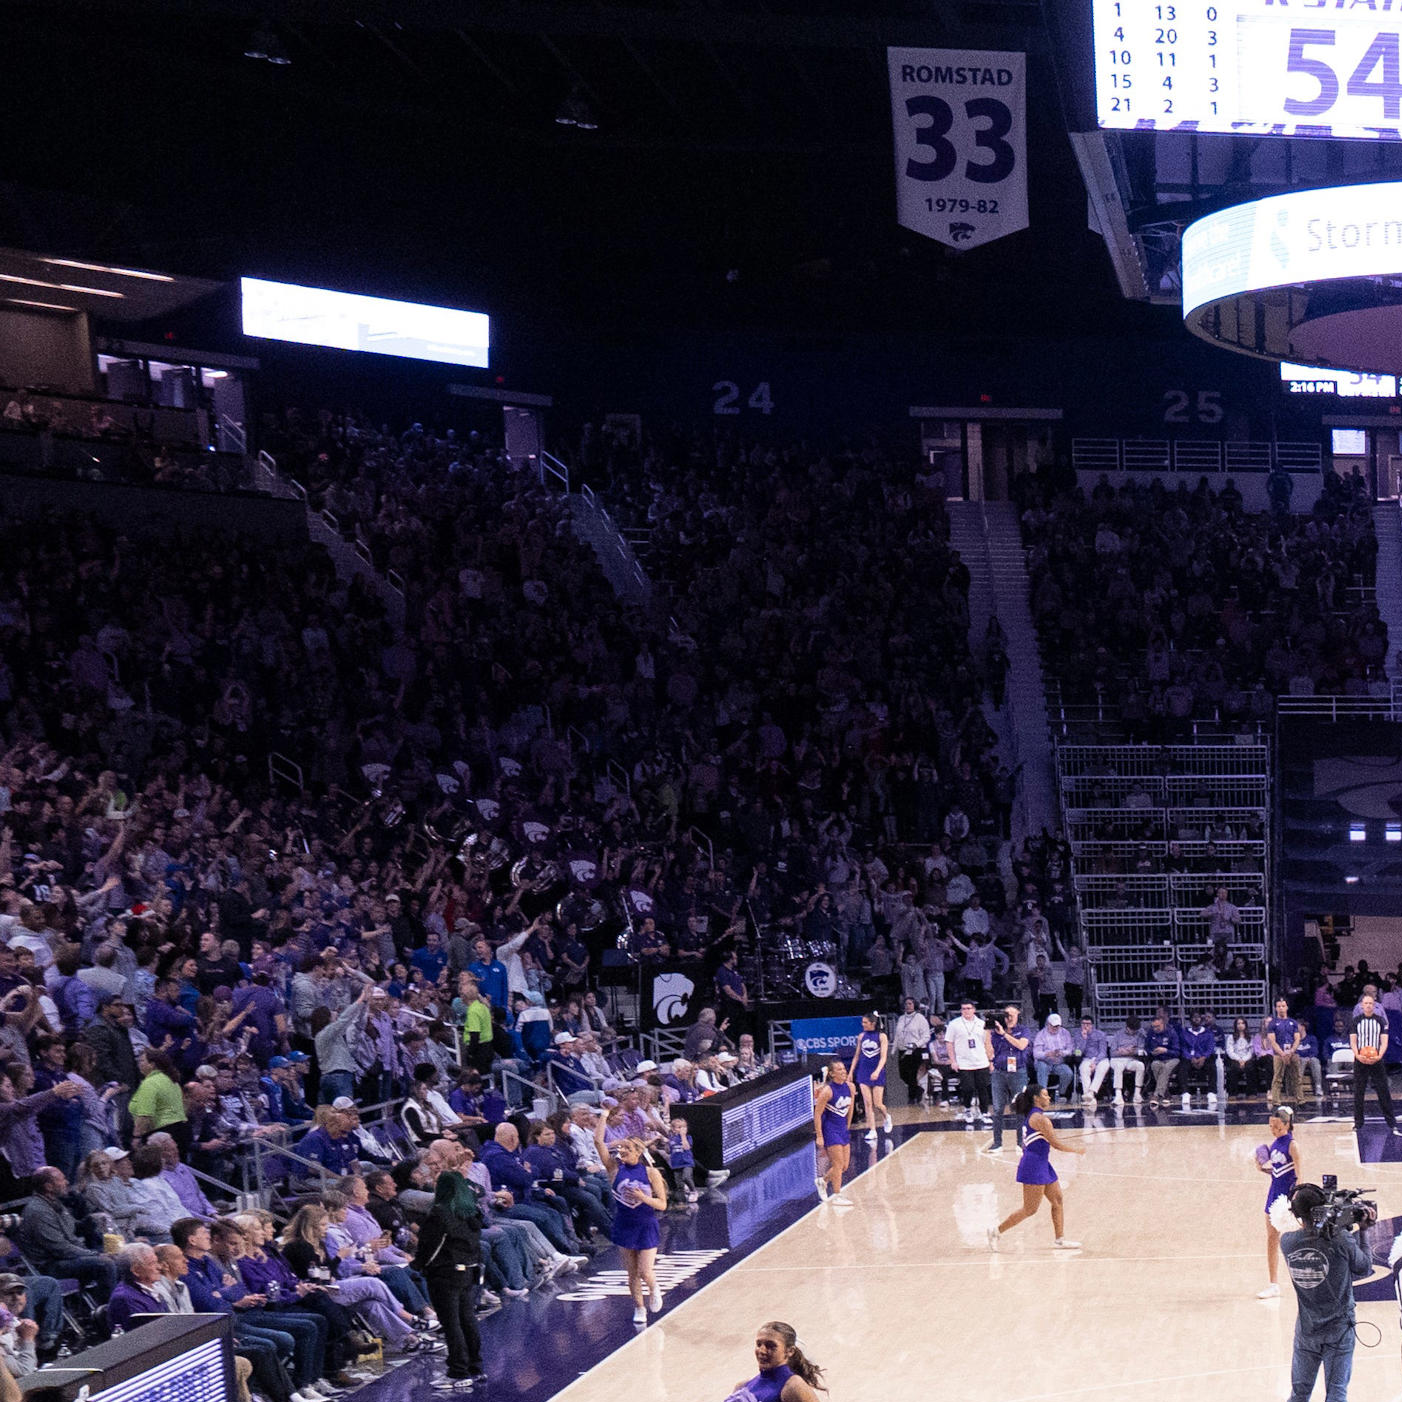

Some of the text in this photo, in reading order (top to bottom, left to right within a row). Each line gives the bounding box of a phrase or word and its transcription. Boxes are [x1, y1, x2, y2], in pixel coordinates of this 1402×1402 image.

[1114, 3, 1217, 22] 1 13 0
[1114, 27, 1217, 46] 4 20 3
[1109, 50, 1216, 69] 10 11 1
[901, 65, 1013, 86] ROMSTAD
[1111, 74, 1219, 93] 15 4 3
[1111, 97, 1217, 115] 21 2 1
[905, 95, 1015, 184] 33
[925, 198, 999, 214] 1979-82
[1316, 382, 1335, 393] PM
[712, 381, 775, 415] 24
[1164, 390, 1224, 423] 25
[806, 1036, 858, 1049] CBS SPOR
